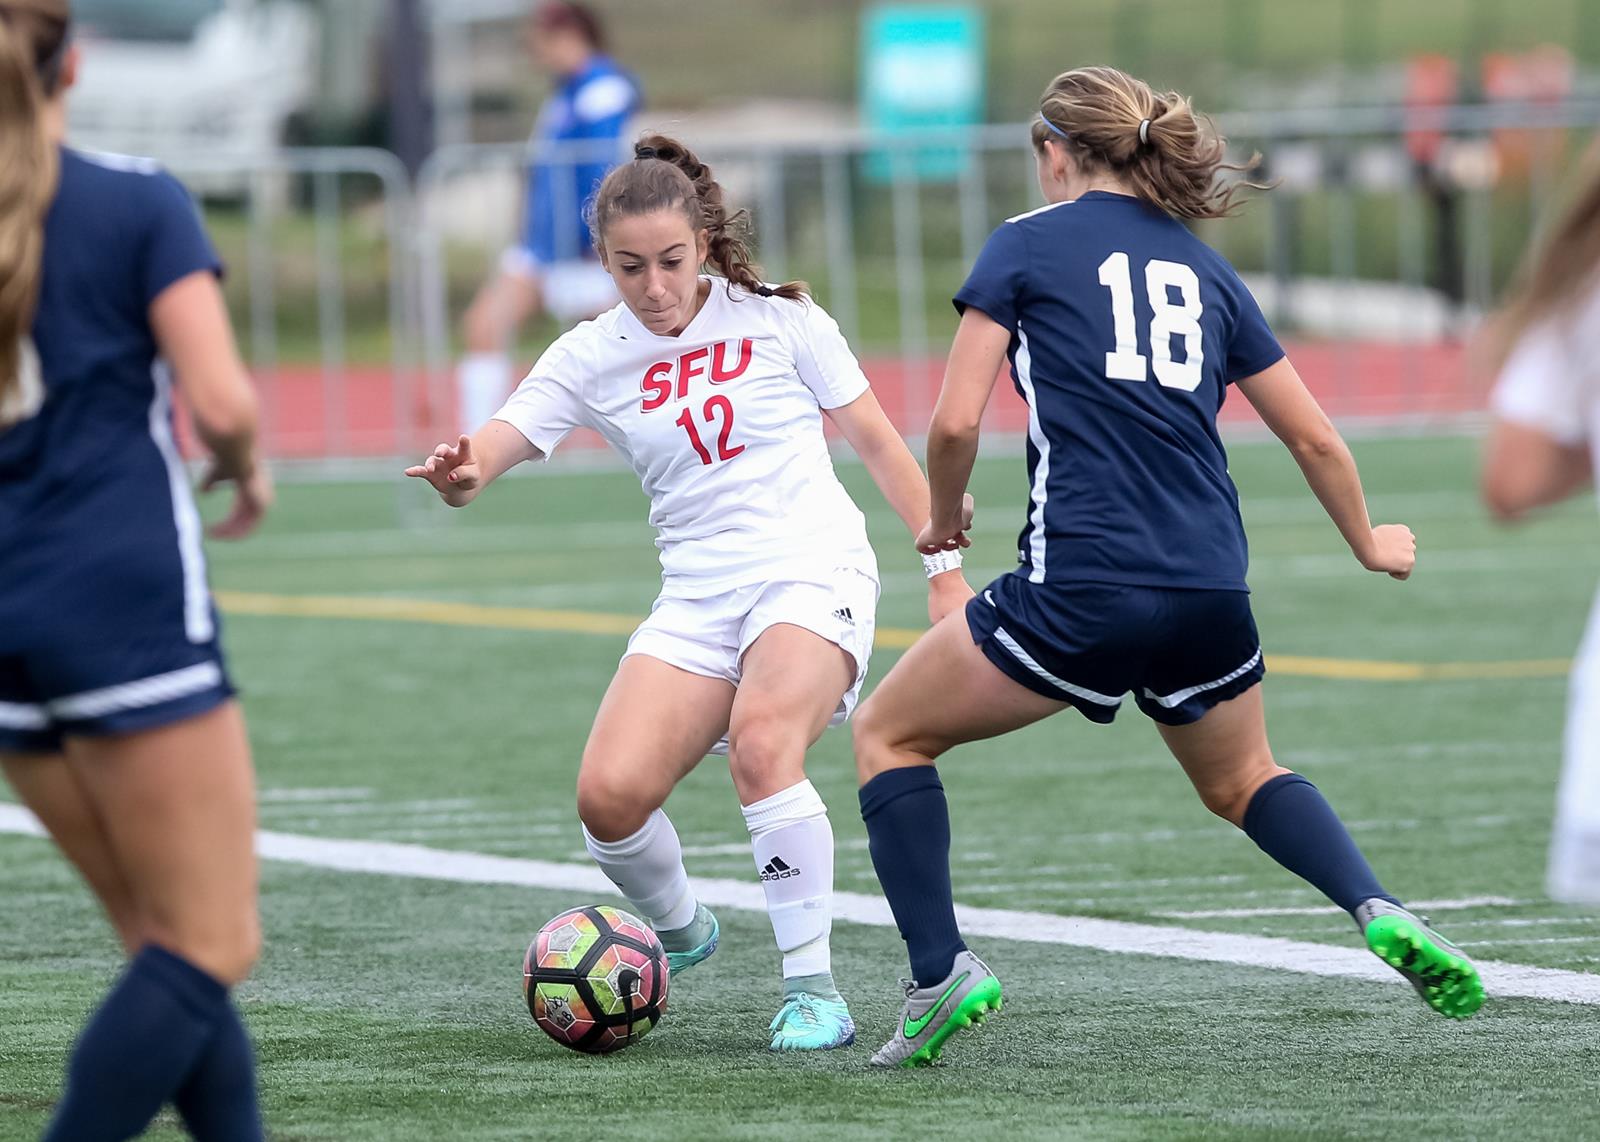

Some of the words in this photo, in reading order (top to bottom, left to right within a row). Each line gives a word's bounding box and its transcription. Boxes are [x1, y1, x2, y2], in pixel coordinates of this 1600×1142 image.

[1098, 251, 1204, 392] 18
[640, 338, 753, 413] SFU
[675, 394, 746, 466] 12
[759, 867, 801, 881] adidas
